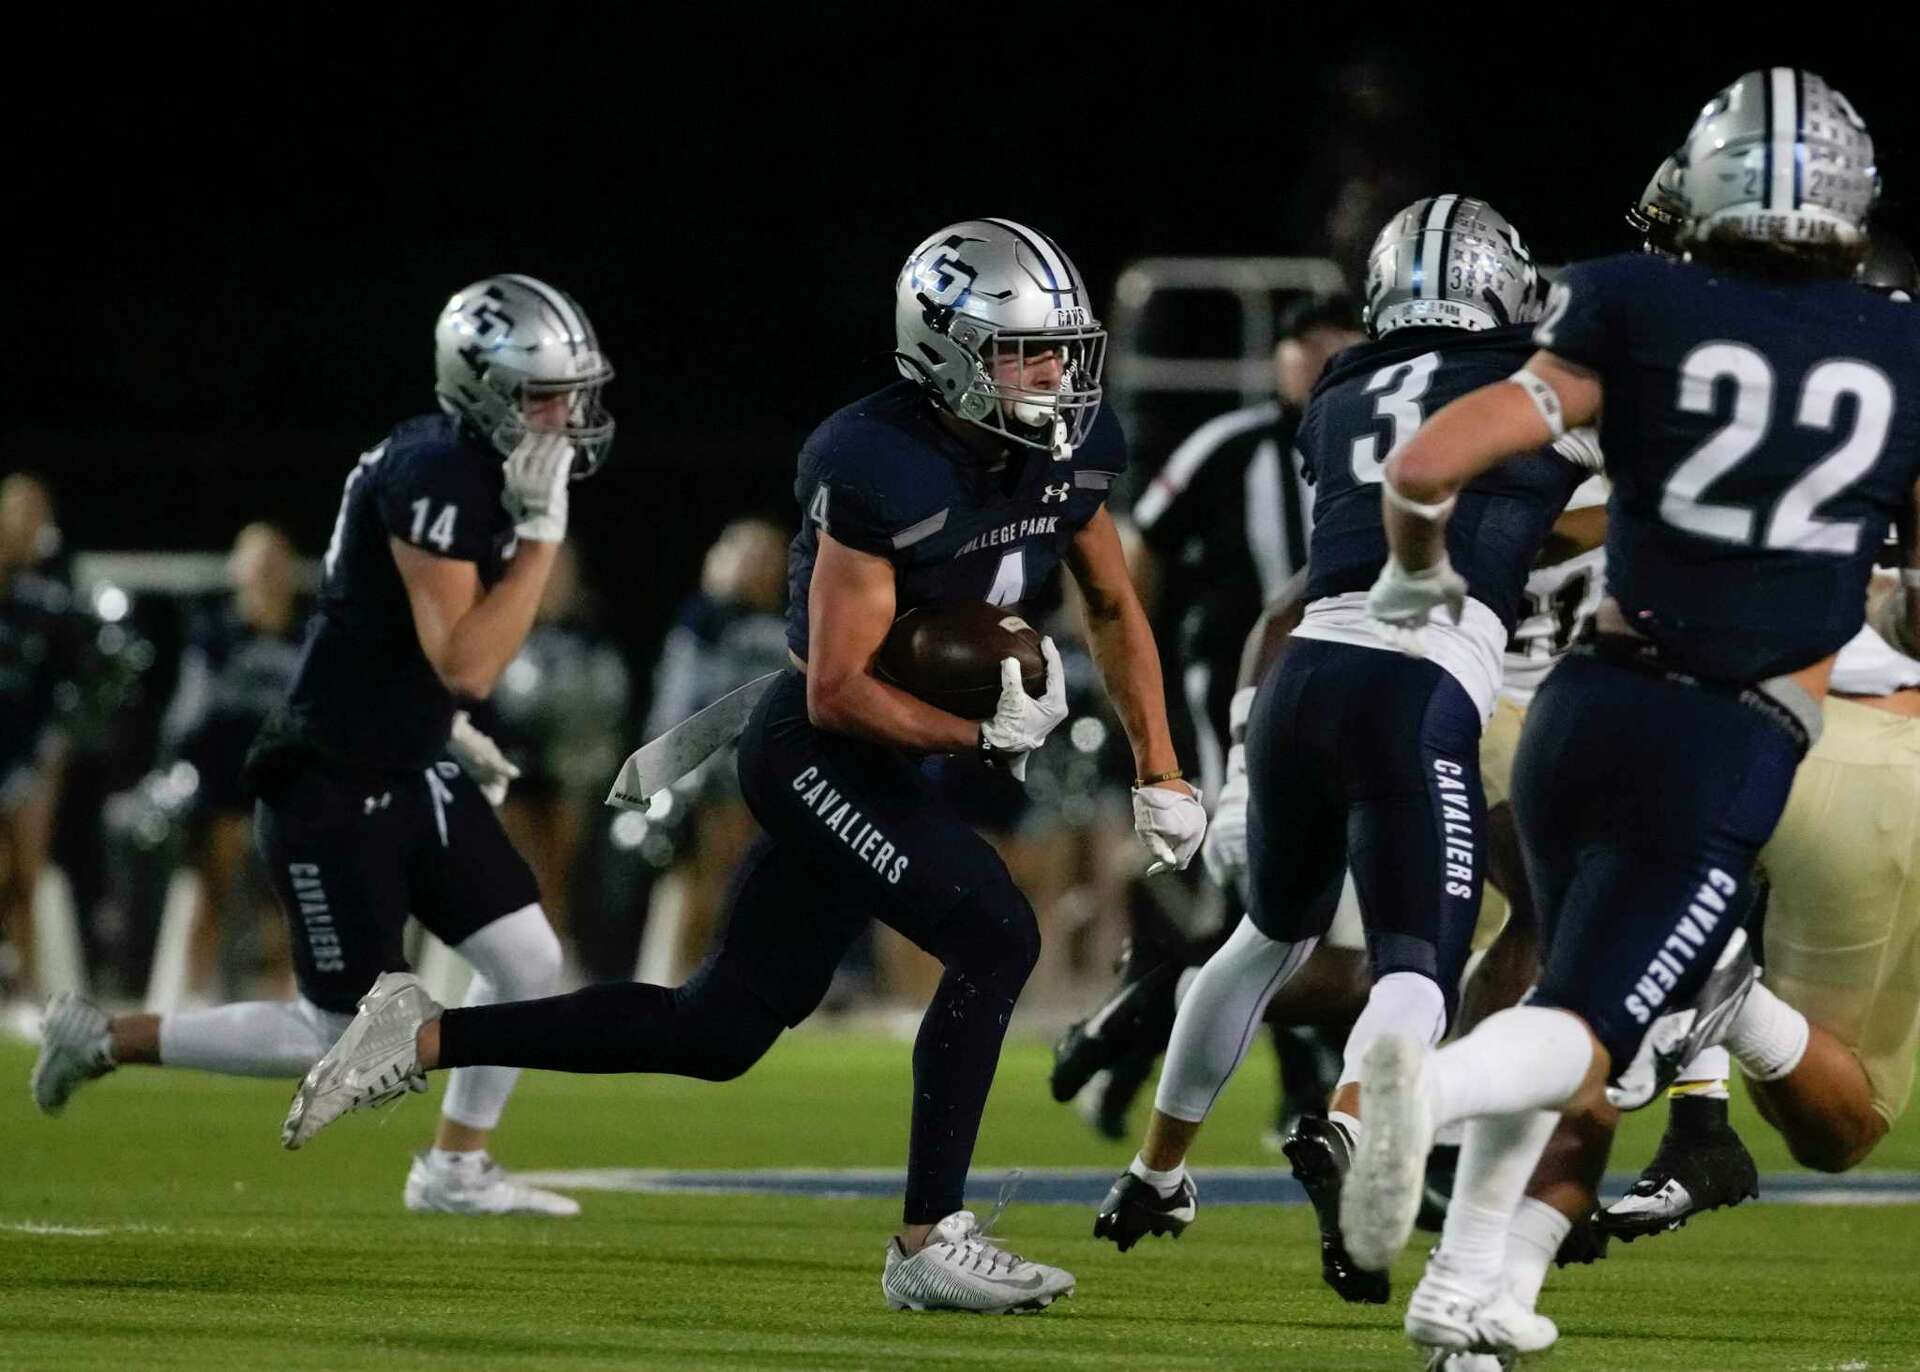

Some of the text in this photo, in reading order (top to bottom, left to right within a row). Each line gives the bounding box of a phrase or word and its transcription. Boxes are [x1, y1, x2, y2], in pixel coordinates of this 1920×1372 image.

[1057, 309, 1085, 327] CAVS
[1450, 265, 1463, 290] 3
[1350, 350, 1440, 485] 3
[1658, 341, 1896, 556] 22
[410, 498, 456, 551] 14
[809, 482, 831, 531] 4
[1019, 516, 1060, 537] PARK
[791, 765, 910, 885] CAVALIERS
[1432, 758, 1474, 900] CAVALIERS
[288, 862, 346, 973] CAVALIERS
[1624, 867, 1738, 1025] CAVALIERS
